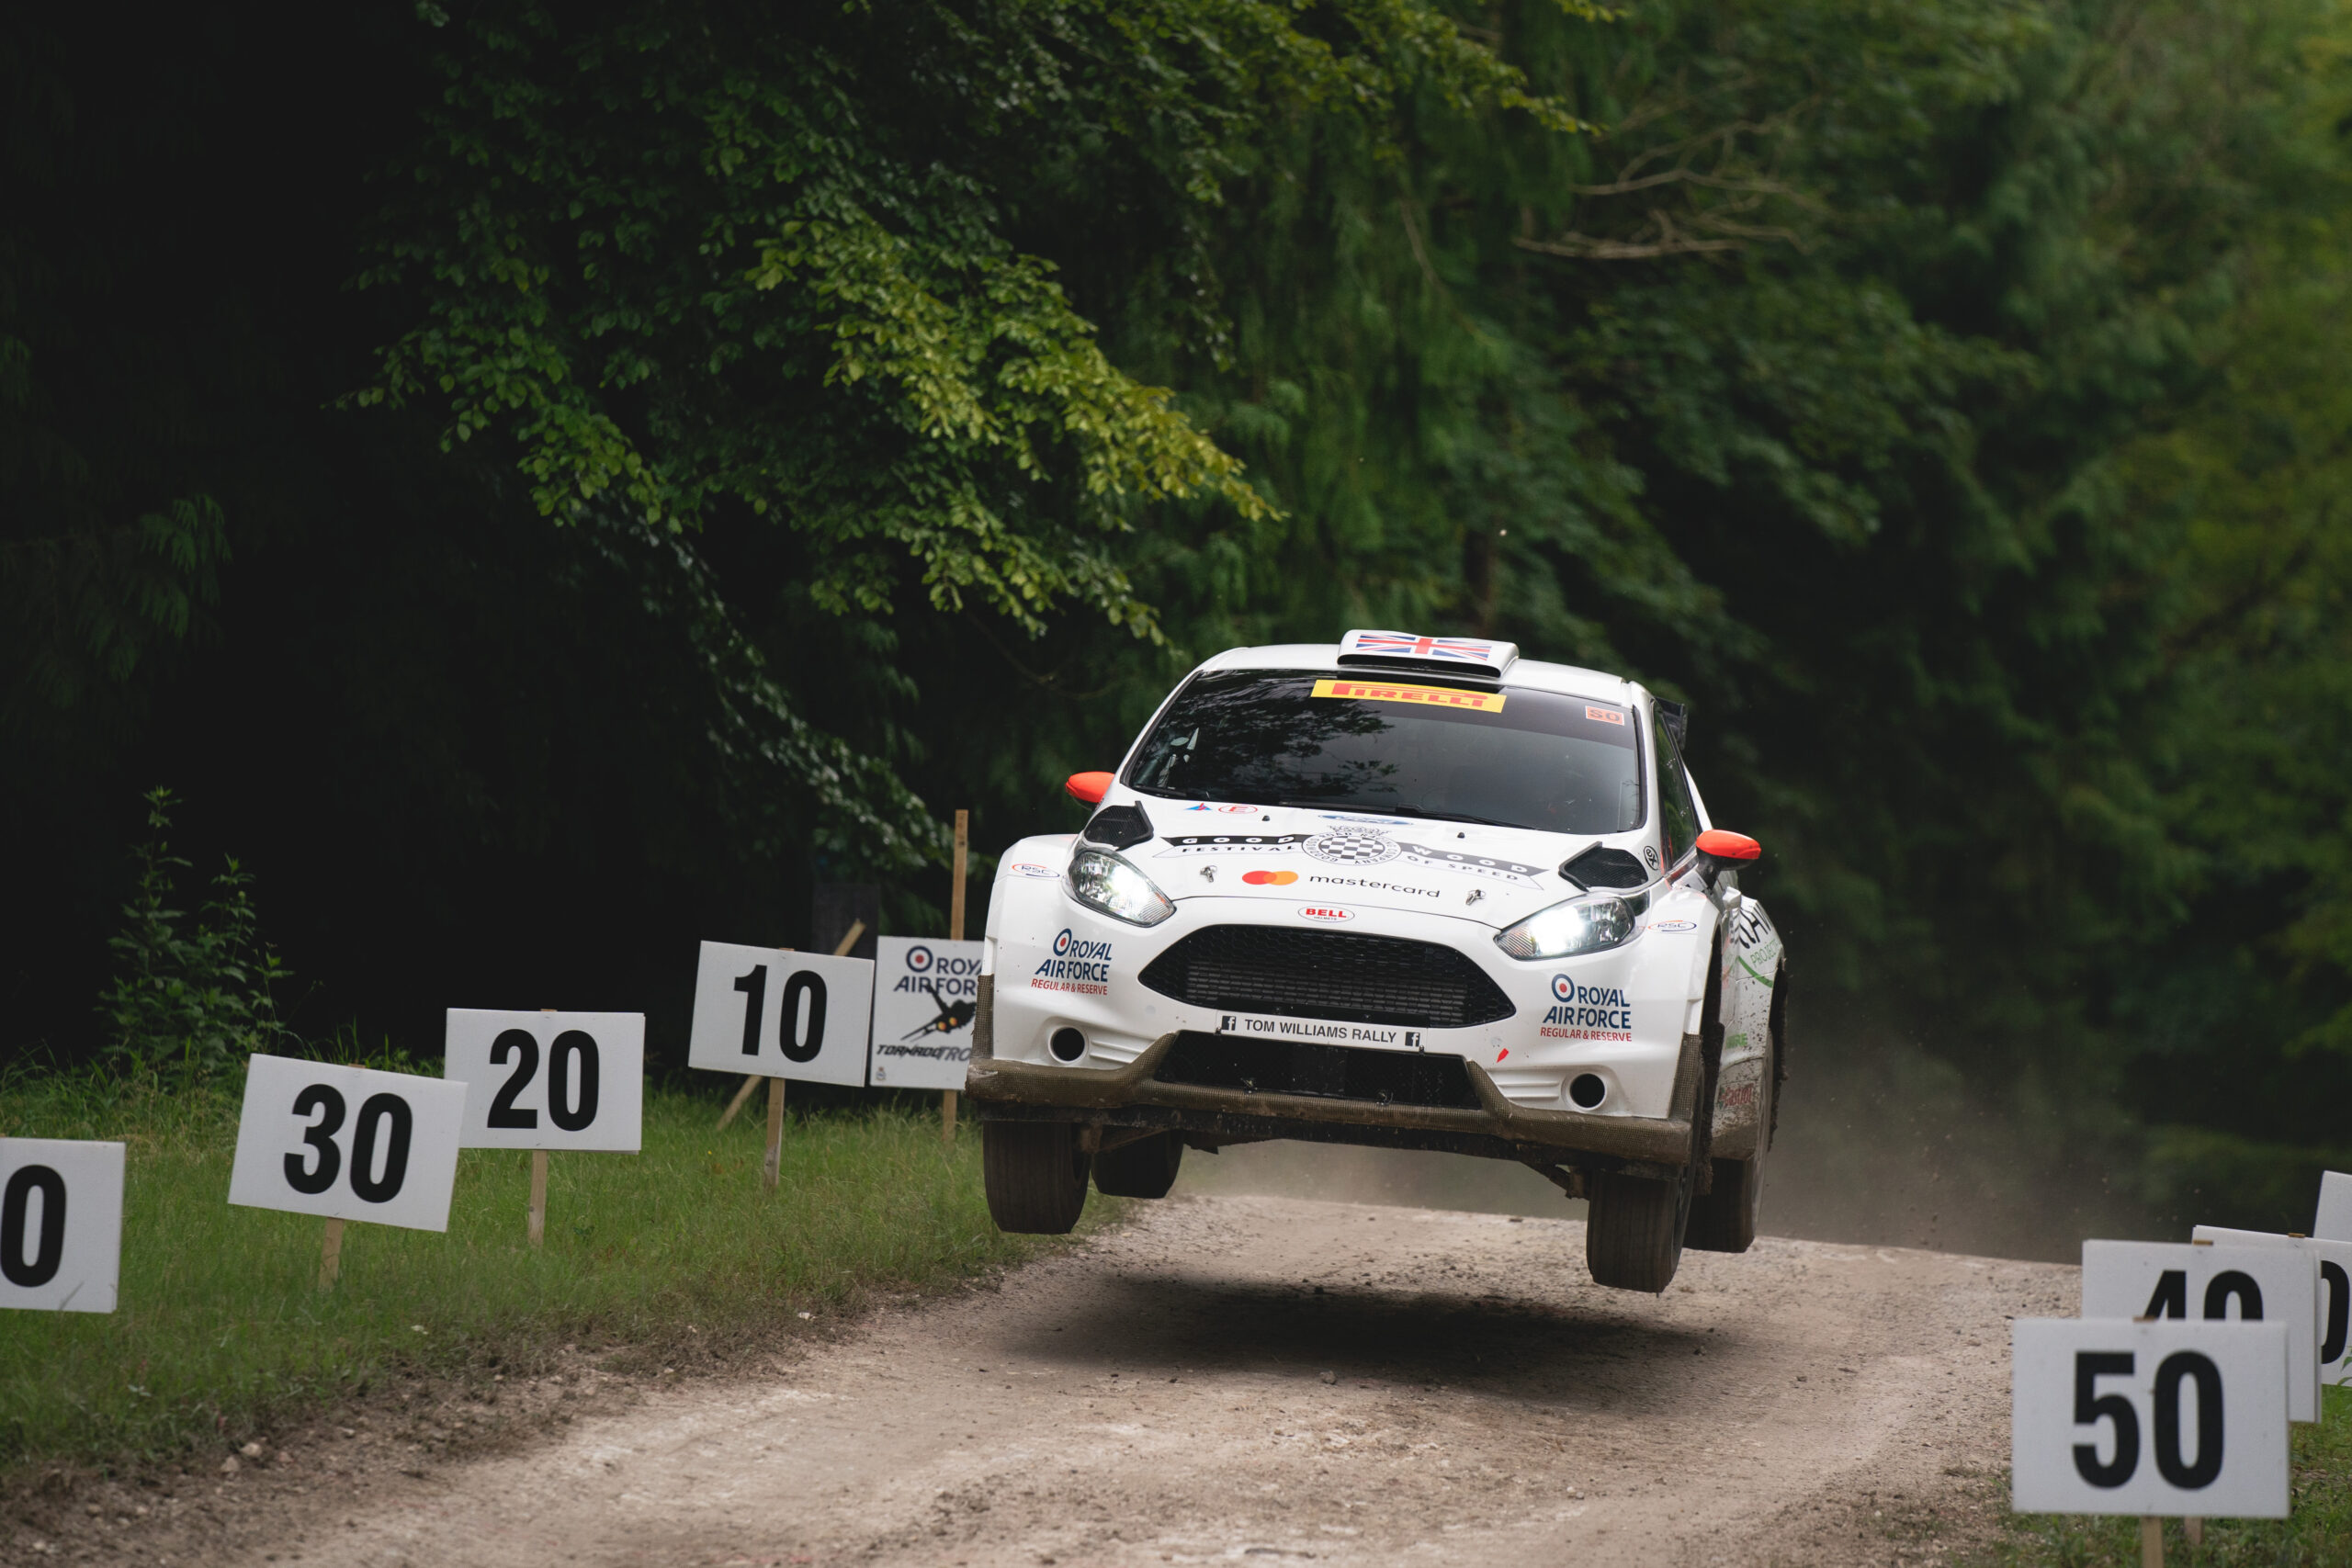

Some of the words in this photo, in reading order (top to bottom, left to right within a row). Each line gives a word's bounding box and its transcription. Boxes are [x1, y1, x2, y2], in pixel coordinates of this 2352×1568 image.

[1331, 682, 1488, 707] PIRELLI
[1182, 836, 1295, 844] GOOD
[1182, 845, 1298, 853] FESTIVAL
[1407, 855, 1433, 865] OF
[1448, 863, 1519, 881] SPEED
[1412, 845, 1528, 874] WOOD
[1309, 874, 1441, 898] mastercard
[1306, 908, 1347, 919] BELL
[1069, 940, 1113, 961] ROYAL
[934, 977, 976, 996] FOR
[1031, 977, 1070, 992] REGULAR
[1077, 983, 1108, 996] RESERVE
[1577, 986, 1631, 1009] ROYAL
[734, 964, 828, 1063] 10
[1245, 1019, 1275, 1032] TOM
[1279, 1022, 1348, 1039] WILLIAMS
[1351, 1029, 1396, 1043] RALLY
[1540, 1026, 1581, 1040] REGULAR
[1582, 1030, 1589, 1040] &
[1590, 1031, 1632, 1043] RESERVE
[487, 1028, 600, 1132] 20
[284, 1083, 413, 1203] 30
[0, 1164, 67, 1288] 0
[2073, 1350, 2225, 1490] 50
